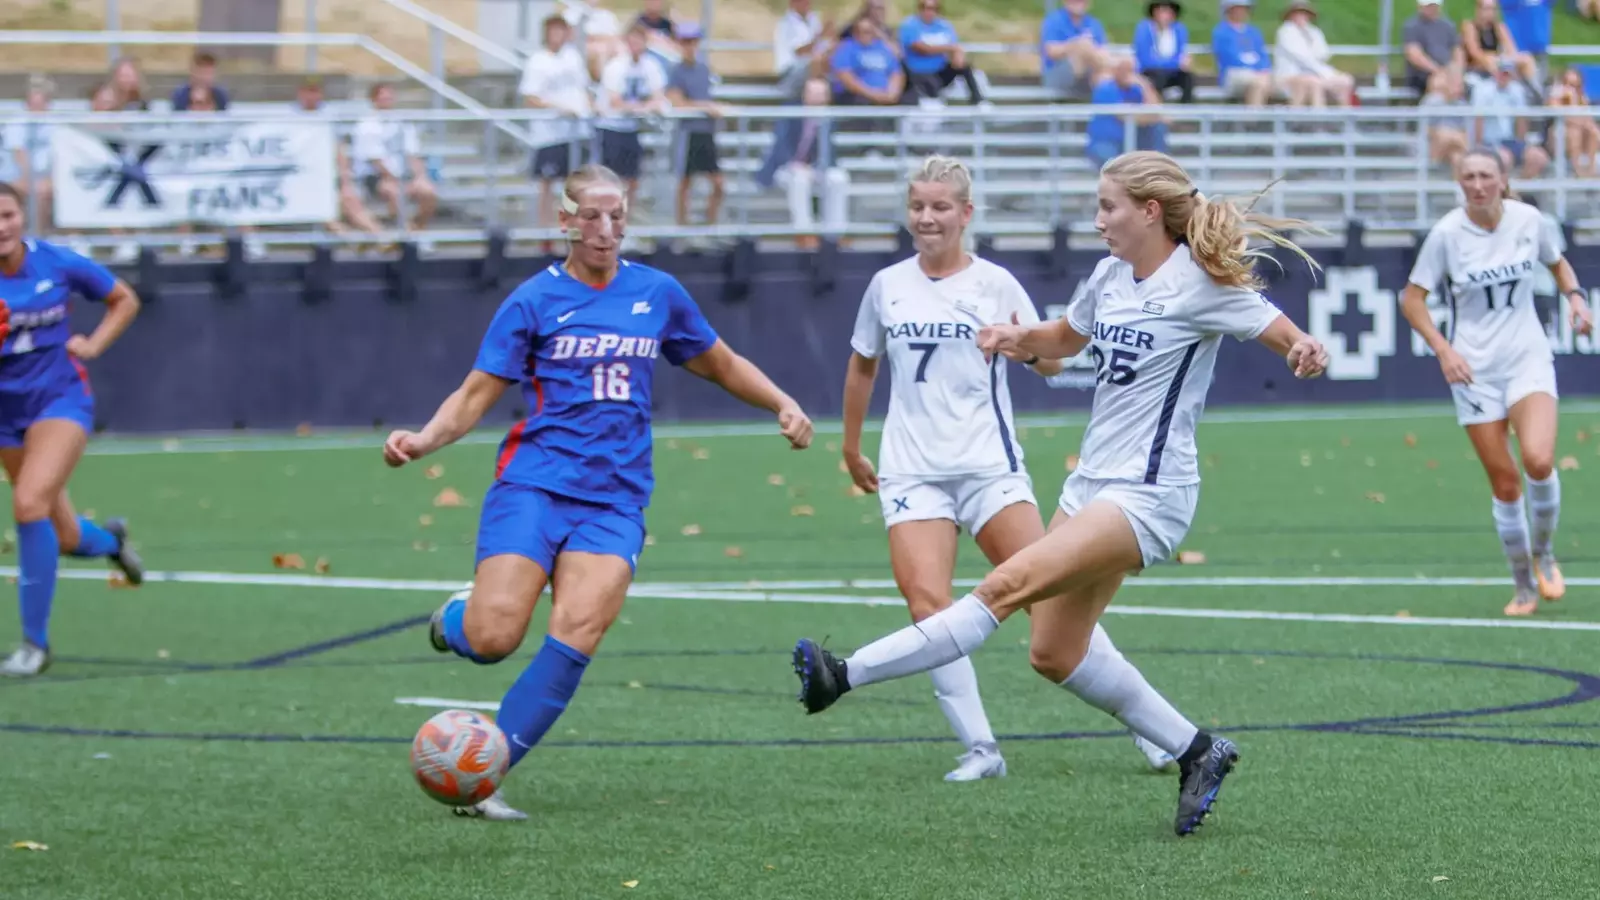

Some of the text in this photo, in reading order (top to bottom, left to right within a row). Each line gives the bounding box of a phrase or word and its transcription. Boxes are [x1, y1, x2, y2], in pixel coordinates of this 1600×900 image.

[1467, 259, 1534, 284] XAVIER
[1482, 279, 1519, 310] 17
[886, 321, 973, 341] XAVIER
[1092, 321, 1155, 351] AVIER
[907, 342, 940, 383] 7
[591, 361, 631, 402] 16
